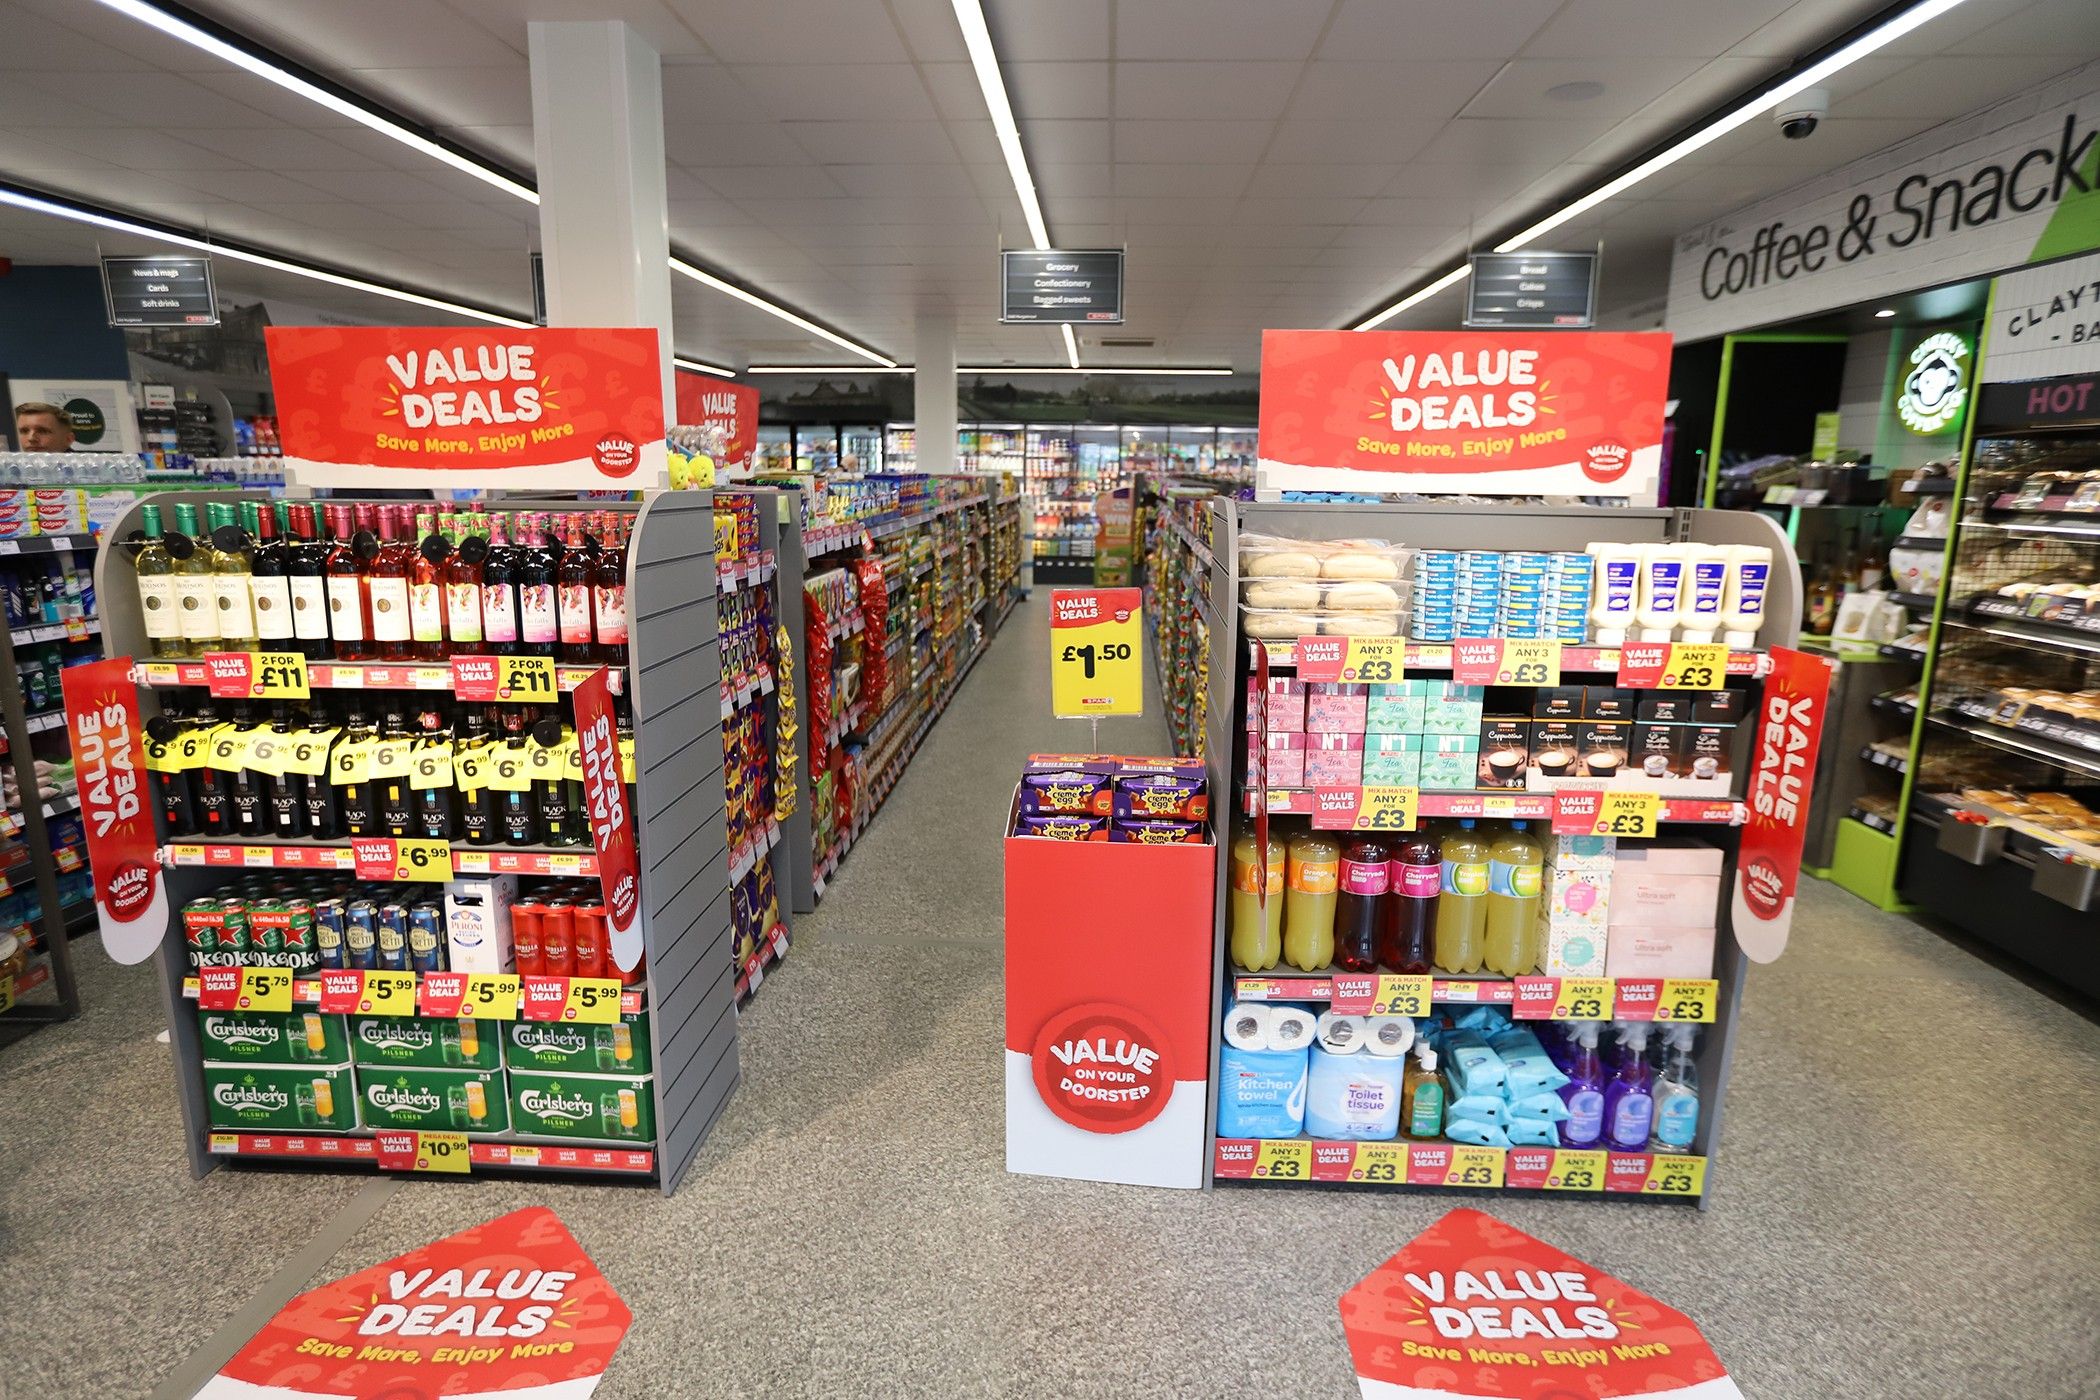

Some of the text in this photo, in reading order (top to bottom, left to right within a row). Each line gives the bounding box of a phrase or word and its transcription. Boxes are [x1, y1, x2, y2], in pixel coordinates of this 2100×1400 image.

[1702, 113, 2100, 299] Coffee & Snack
[133, 269, 153, 277] News
[160, 270, 179, 278] mags
[1046, 263, 1079, 272] Grocery
[147, 284, 169, 292] Cards
[1034, 279, 1091, 288] Confectionery
[142, 300, 180, 308] Soft drinks
[1033, 296, 1091, 305] Bagged sweets
[386, 345, 536, 389] VALUE
[1382, 349, 1539, 393] VALUE
[702, 392, 737, 416] VALUE
[2027, 382, 2094, 414] HOT
[401, 386, 543, 429] DEALS
[1390, 391, 1537, 432] DEALS
[376, 423, 574, 454] Save More, Enjoy More
[1357, 428, 1566, 458] Save More, Enjoy More
[595, 439, 634, 454] VALUE
[1586, 444, 1627, 459] VALUE
[600, 456, 632, 466] DOORSTEP
[1057, 598, 1096, 609] VALUE
[1060, 608, 1098, 620] DEALS
[1304, 643, 1340, 653] VALUE
[1360, 646, 1393, 654] ANY 3
[1626, 649, 1663, 659] VALUE
[210, 659, 244, 669] VALUE
[261, 656, 294, 665] 2 FOR
[1062, 643, 1131, 678] £1.50
[1305, 652, 1341, 662] DEALS
[1627, 658, 1662, 668] DEALS
[214, 667, 247, 678] DEALS
[261, 667, 302, 688] £11
[1358, 662, 1392, 680] £3
[1679, 668, 1713, 687] £3
[180, 738, 208, 757] £6.99
[103, 702, 140, 820] DEALS
[334, 753, 367, 771] £6.99
[1327, 756, 1342, 766] Tea
[1754, 696, 1789, 818] DEALS
[1774, 697, 1813, 827] VALUE
[457, 755, 488, 777] £6.99
[597, 714, 623, 831] DEALS
[78, 710, 116, 838] VALUE
[583, 725, 611, 852] VALUE
[1053, 791, 1078, 800] creme
[1057, 797, 1073, 806] egg
[1147, 795, 1172, 804] creme
[1319, 793, 1354, 801] VALUE
[1373, 795, 1397, 803] ANY
[1152, 801, 1168, 810] egg
[1321, 801, 1355, 810] DEALS
[1372, 810, 1405, 828] £3
[357, 844, 390, 854] VALUE
[361, 853, 392, 862] DEALS
[401, 847, 447, 867] £6.99
[1303, 869, 1328, 877] Orange
[1352, 869, 1385, 878] Cherryade
[108, 868, 148, 894] VALUE
[115, 887, 149, 907] DOORSTEP
[611, 875, 633, 904] VALUE
[1659, 892, 1676, 900] soft
[451, 922, 483, 931] PERONI
[204, 973, 236, 983] VALUE
[246, 975, 289, 996] £5.79
[206, 981, 236, 991] DEALS
[529, 983, 562, 993] VALUE
[531, 991, 563, 1002] DEALS
[573, 987, 618, 1008] £5.99
[205, 1017, 279, 1044] Carlsberg
[512, 1025, 586, 1052] Carlsberg
[1050, 1038, 1160, 1075] VALUE
[1075, 1069, 1136, 1083] ON YOUR
[1060, 1078, 1150, 1102] DOORSTEP
[1238, 1079, 1293, 1089] Kitchen
[368, 1084, 440, 1113] Carlsberg
[1238, 1090, 1277, 1100] towel
[1349, 1089, 1383, 1100] Toilet
[520, 1089, 593, 1119] Carlsberg
[1348, 1100, 1384, 1110] tissue
[381, 1137, 411, 1145] VALUE
[421, 1141, 466, 1156] £10.99
[384, 1145, 412, 1153] DEALS
[1220, 1145, 1253, 1153] VALUE
[1222, 1152, 1253, 1160] DEALS
[1269, 1161, 1300, 1177] £3
[387, 1268, 577, 1301] VALUE
[1404, 1271, 1598, 1303] VALUE
[357, 1304, 555, 1337] DEALS
[1427, 1305, 1622, 1339] DEALS
[296, 1337, 574, 1366] Save More, Enjoy More
[1401, 1340, 1672, 1368] Save More, Enjoy More
